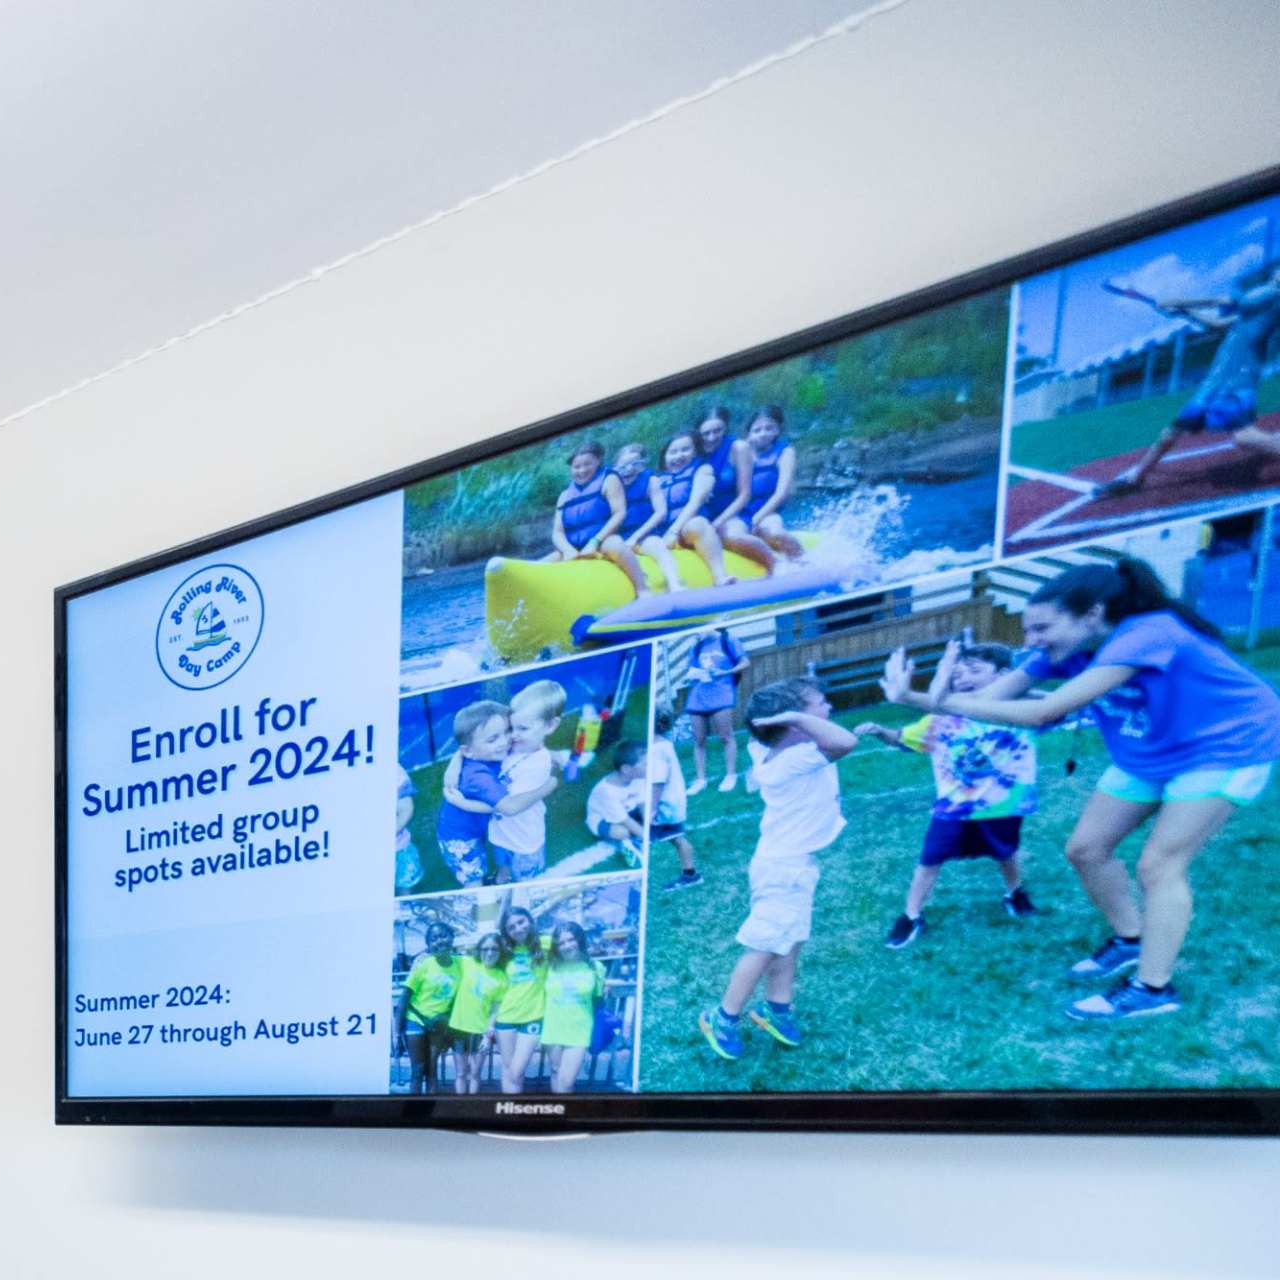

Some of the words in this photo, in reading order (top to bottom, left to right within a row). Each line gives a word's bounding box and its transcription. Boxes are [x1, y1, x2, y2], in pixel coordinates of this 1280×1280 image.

[170, 580, 213, 626] Rolling
[215, 576, 247, 604] River
[178, 654, 202, 678] Day
[206, 641, 241, 672] Camp
[130, 704, 244, 764] Enroll
[254, 696, 318, 736] for
[82, 763, 237, 818] Summer
[247, 724, 375, 787] 2024!
[125, 813, 223, 854] Limited
[232, 803, 320, 843] group
[114, 857, 183, 892] spots
[190, 830, 330, 877] available!
[74, 992, 160, 1013] Summer
[165, 983, 231, 1008] 2024:
[74, 1027, 123, 1047] June
[127, 1025, 155, 1045] 27
[159, 1020, 247, 1047] through
[253, 1016, 339, 1044] August
[346, 1012, 377, 1036] 21
[495, 1101, 566, 1115] Hisense
